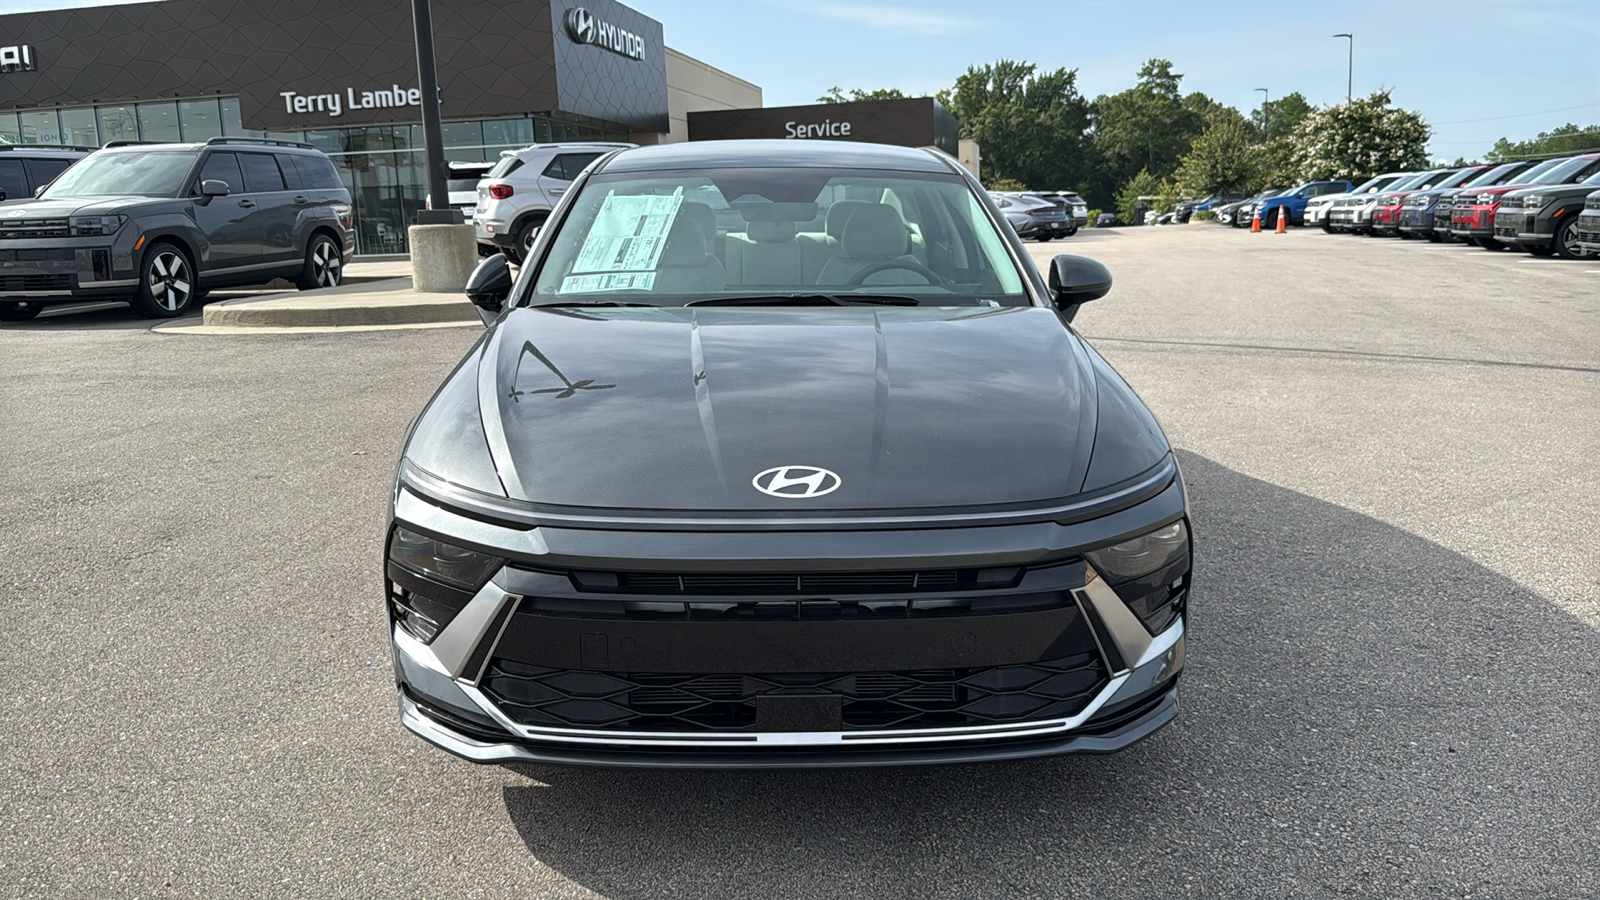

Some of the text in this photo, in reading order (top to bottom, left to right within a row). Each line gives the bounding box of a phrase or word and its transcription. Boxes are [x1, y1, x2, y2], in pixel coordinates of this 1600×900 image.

[597, 18, 645, 61] HYUNDAI
[279, 84, 442, 116] Terry Lambe
[40, 133, 69, 142] IONQ
[785, 118, 851, 139] Service
